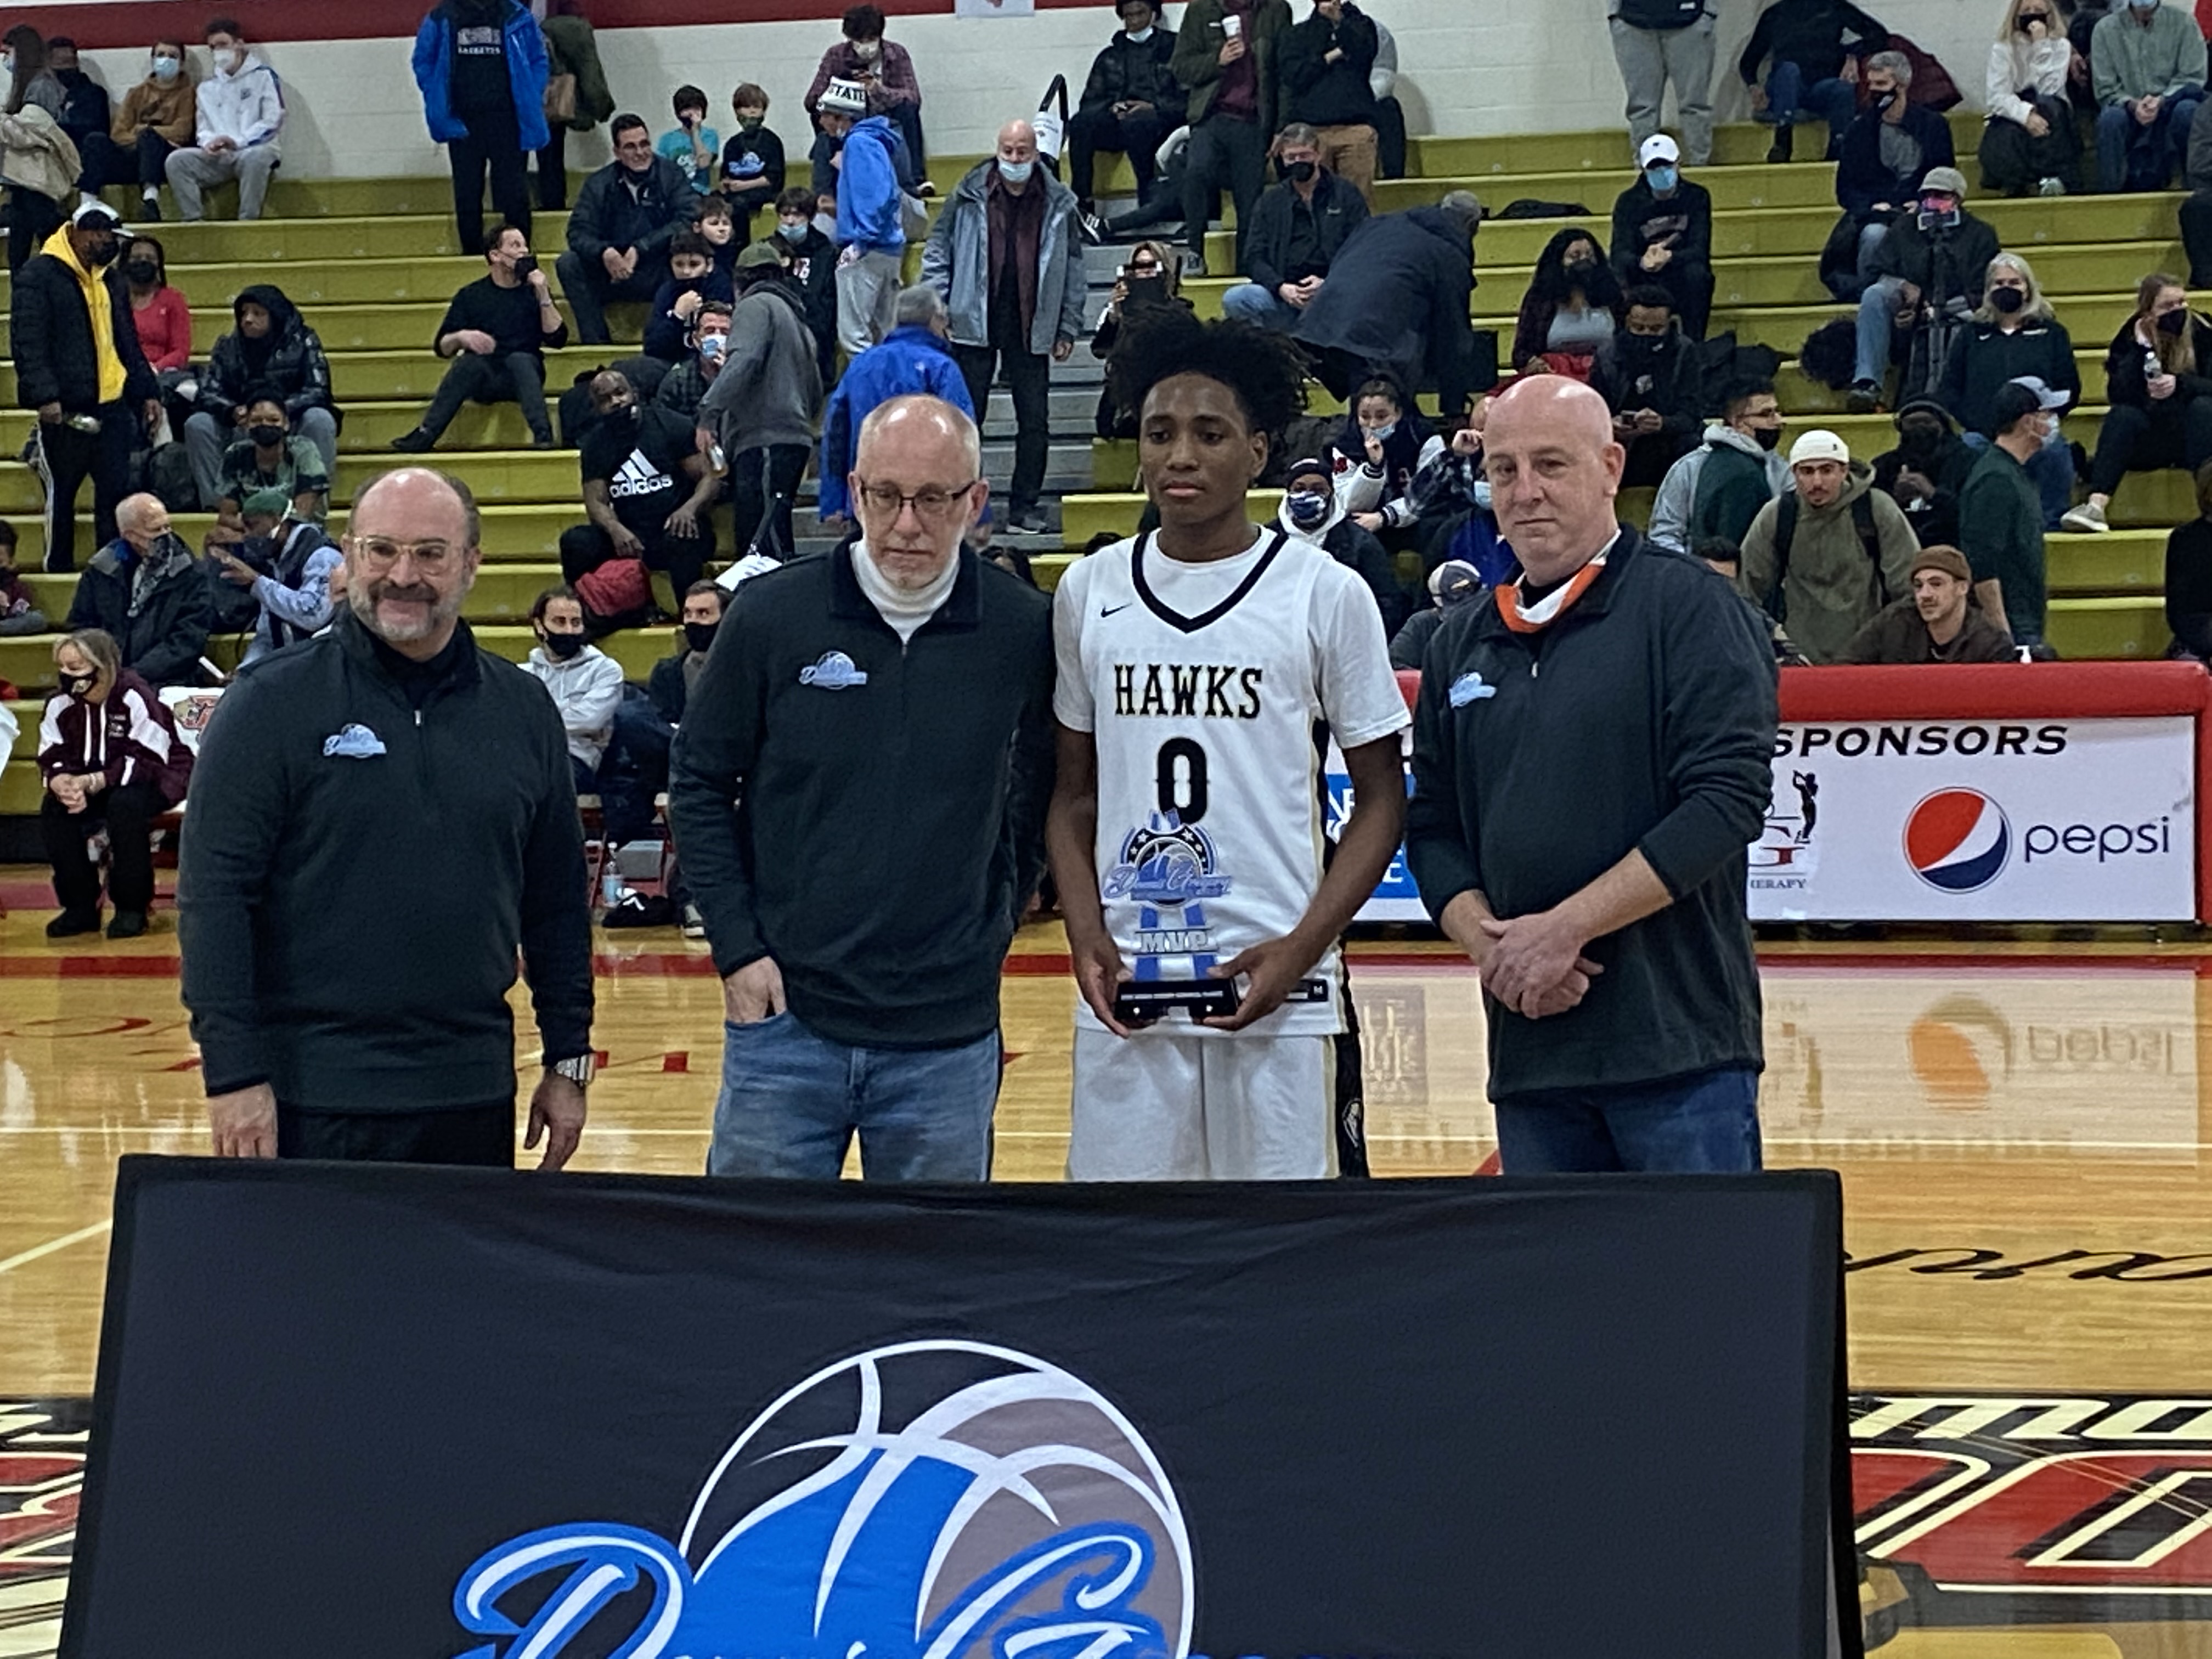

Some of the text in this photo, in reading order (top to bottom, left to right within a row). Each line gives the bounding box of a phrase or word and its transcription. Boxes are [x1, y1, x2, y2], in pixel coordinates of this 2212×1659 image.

[610, 475, 673, 498] adidas
[1114, 664, 1263, 719] HAWKS
[1774, 725, 2068, 758] SPONSORS
[1156, 736, 1209, 825] 0
[2025, 816, 2169, 863] pepsi
[1141, 931, 1207, 953] MVP
